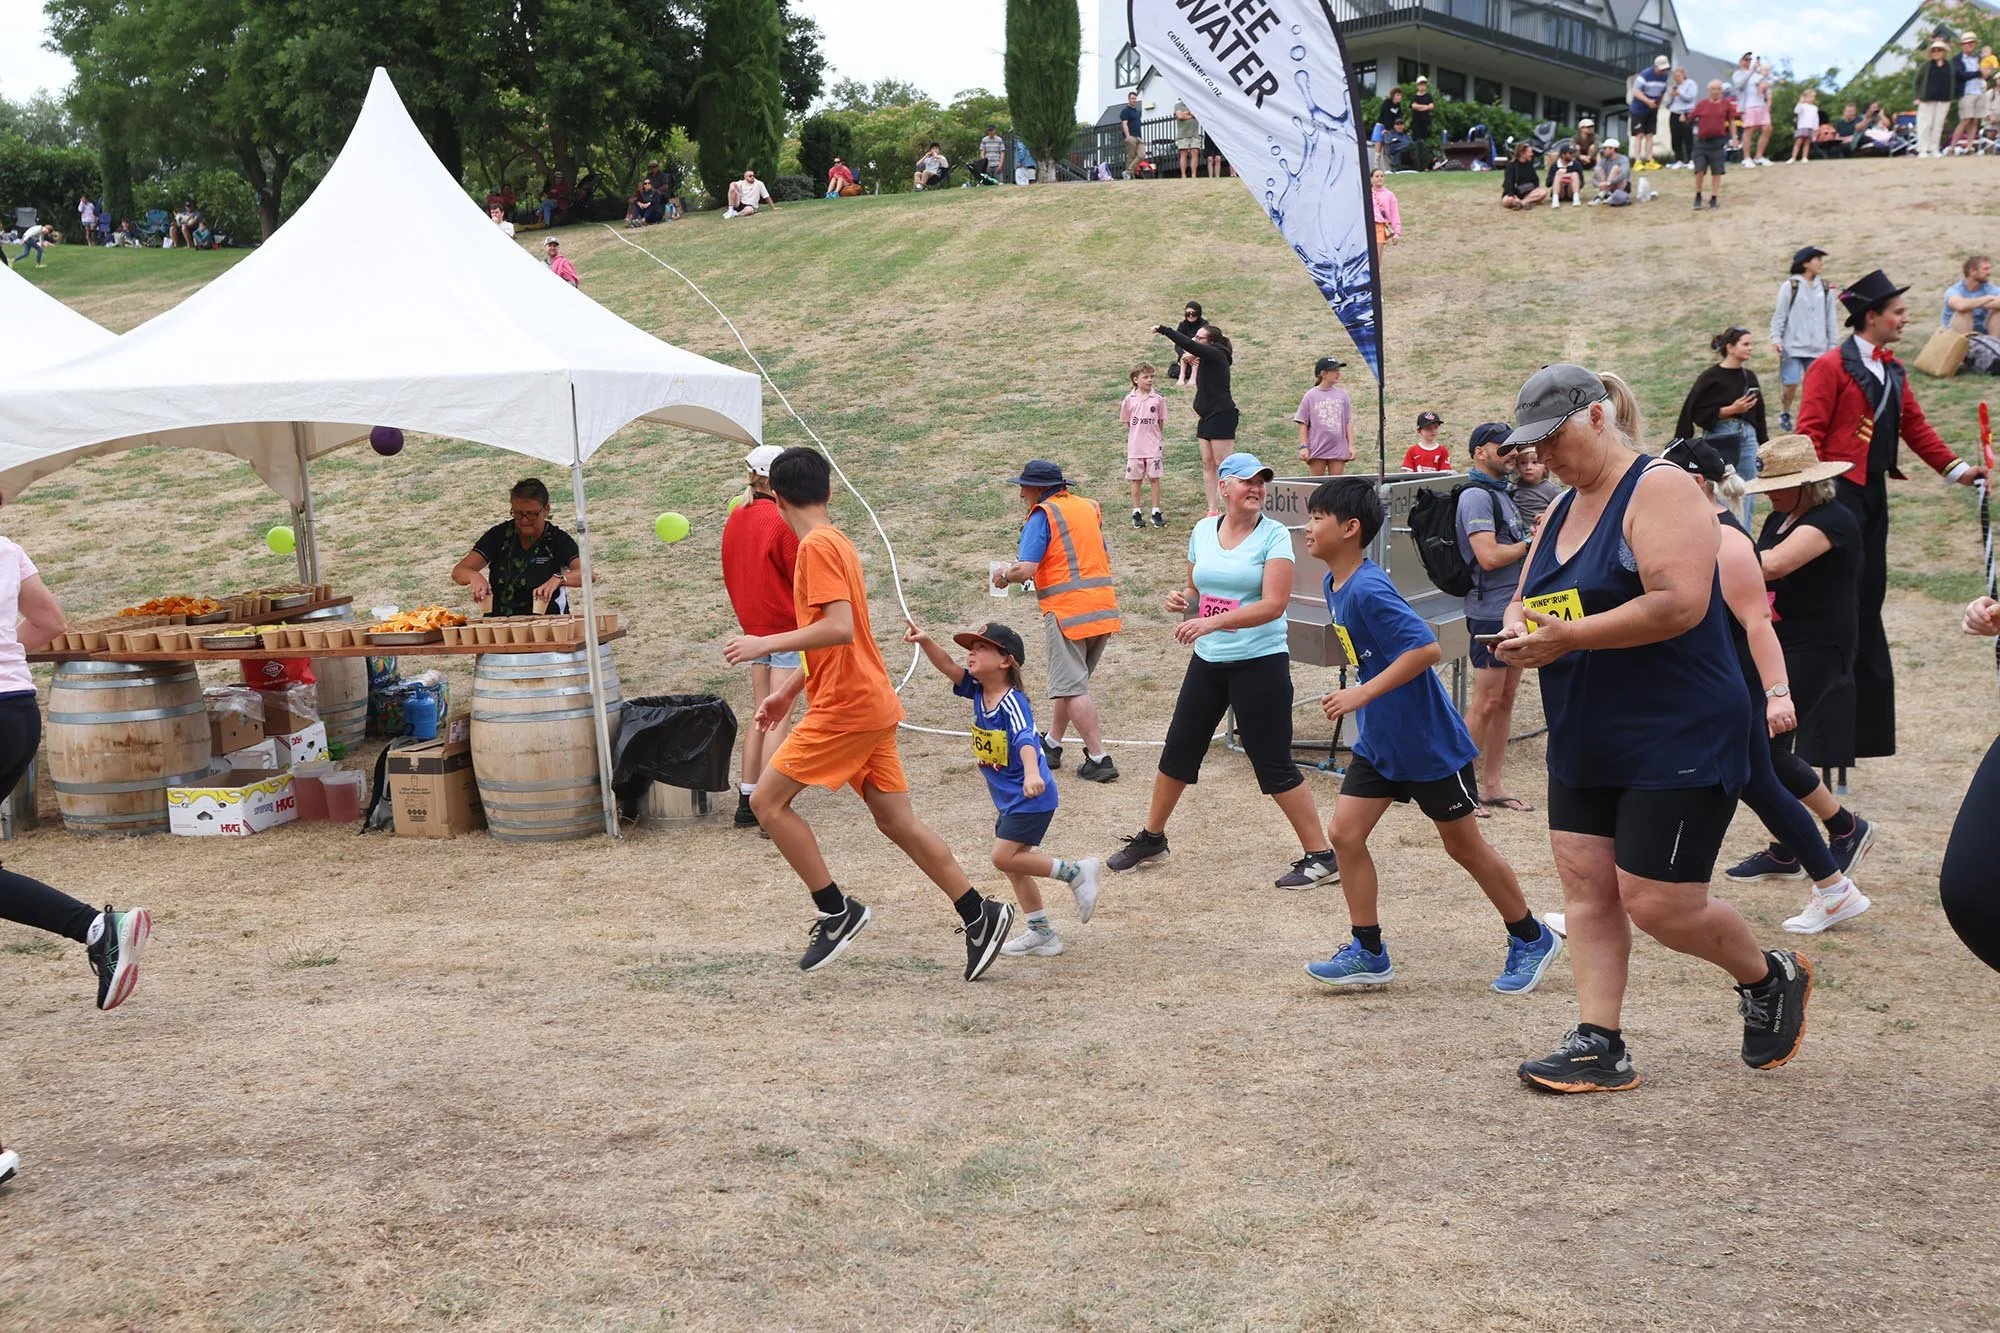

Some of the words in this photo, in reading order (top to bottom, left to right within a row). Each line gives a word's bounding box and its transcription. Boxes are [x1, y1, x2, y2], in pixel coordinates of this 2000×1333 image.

[1224, 0, 1281, 44] EE
[1167, 30, 1223, 98] celabitwater.co.nz
[1263, 486, 1299, 514] abit
[972, 736, 993, 754] 64
[275, 796, 295, 813] HVG
[1448, 802, 1463, 812] FILA
[220, 823, 240, 833] HVG
